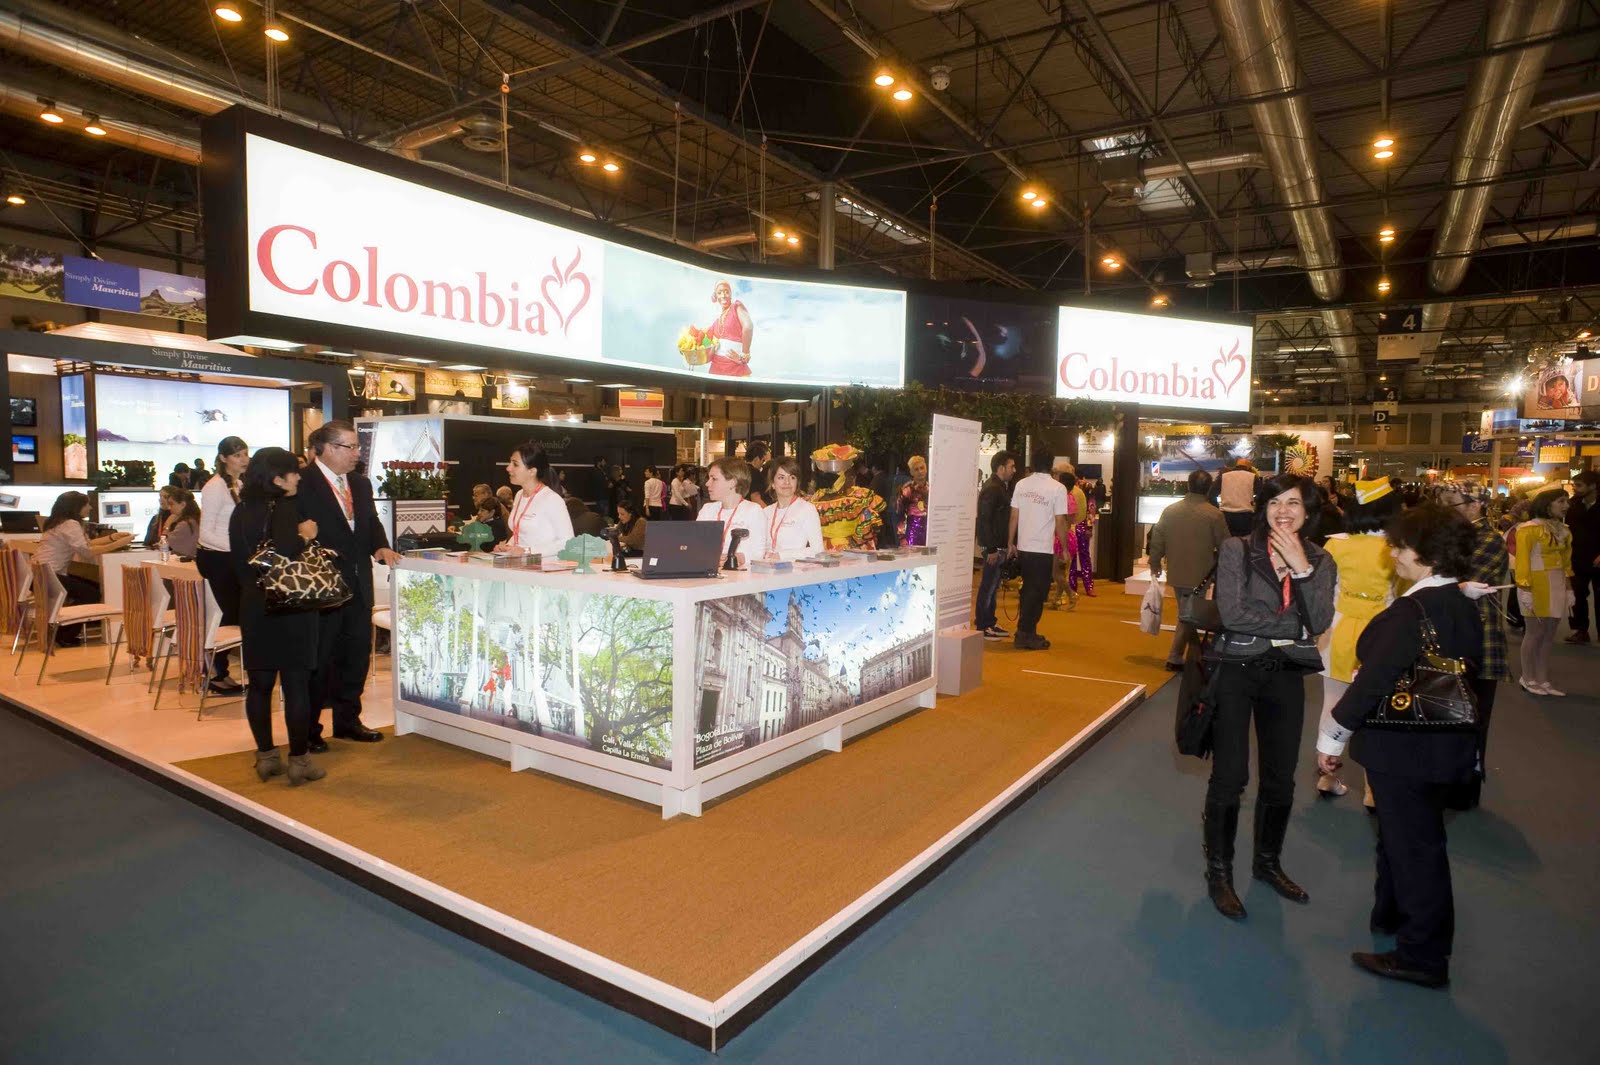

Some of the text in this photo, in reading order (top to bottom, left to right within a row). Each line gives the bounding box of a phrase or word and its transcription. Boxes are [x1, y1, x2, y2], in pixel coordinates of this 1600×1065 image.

[65, 271, 118, 286] Simply Divine
[257, 224, 549, 336] Colombia
[91, 283, 139, 298] Mauritius
[1402, 313, 1417, 330] 4
[151, 347, 209, 361] Simply Divine
[180, 359, 232, 373] Mauritius
[1059, 351, 1216, 400] Colombia
[1386, 390, 1395, 400] 4
[1376, 412, 1386, 422] D
[696, 726, 721, 743] Bogotá
[602, 734, 617, 746] Cali,
[617, 735, 635, 749] Valle
[636, 740, 648, 753] del
[695, 744, 713, 756] Plaza
[713, 739, 723, 748] de
[602, 744, 650, 763] Capilla La Ermita
